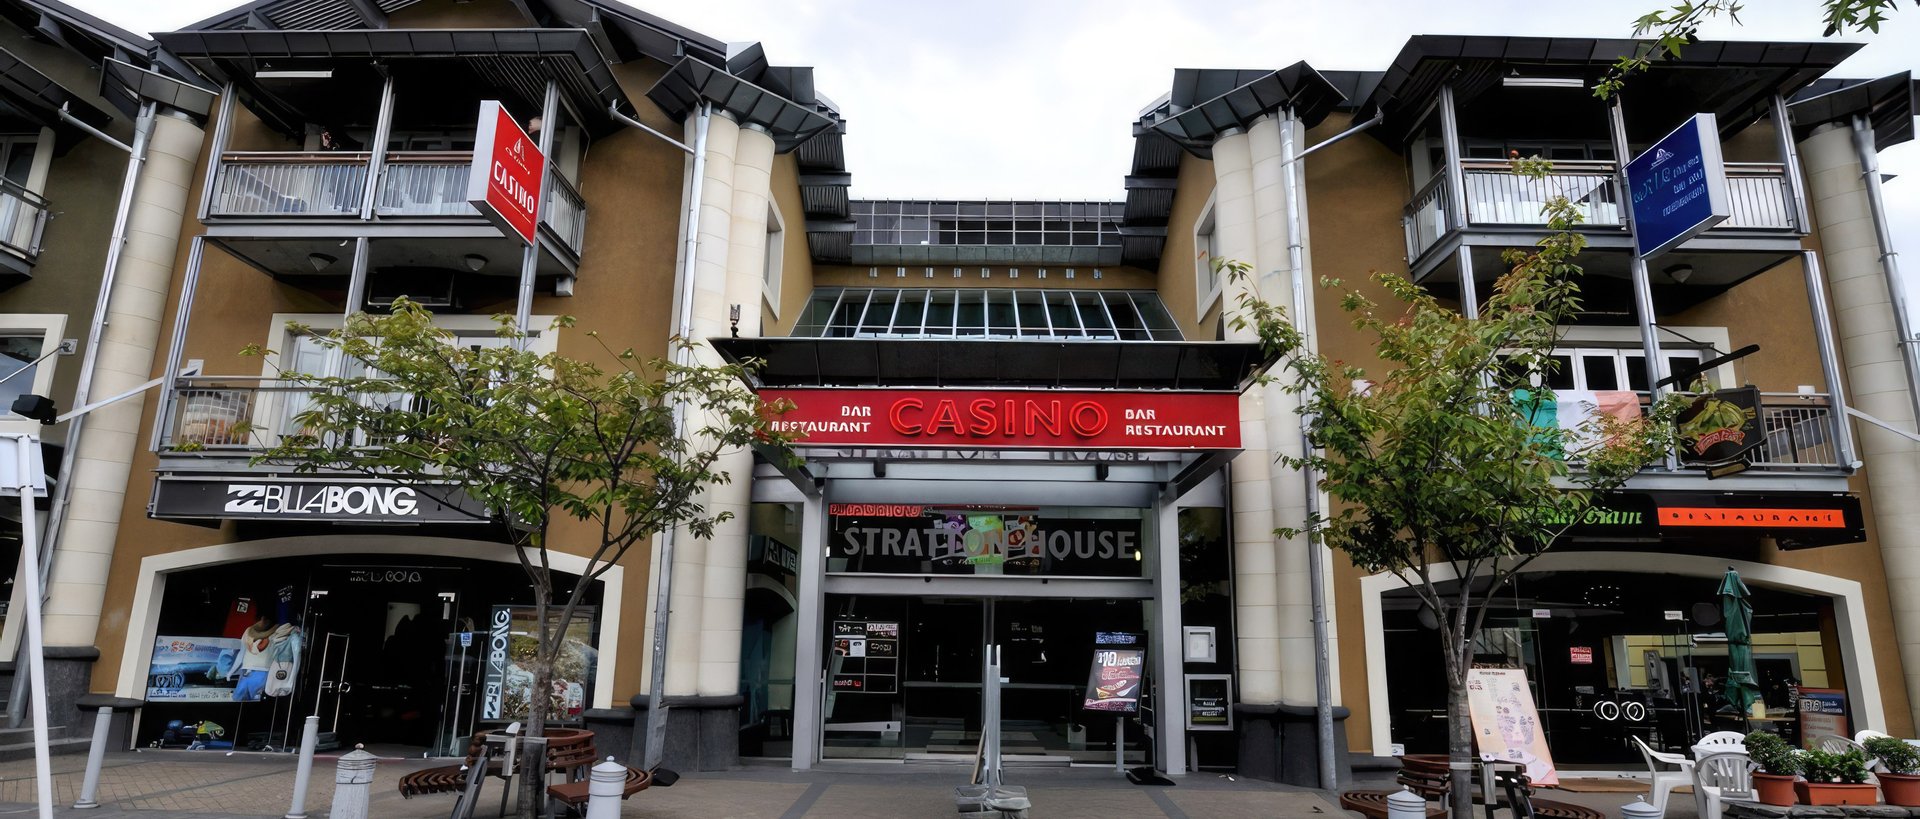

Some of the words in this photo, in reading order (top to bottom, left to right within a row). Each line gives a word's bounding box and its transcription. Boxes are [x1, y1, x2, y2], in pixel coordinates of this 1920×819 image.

[494, 160, 535, 214] CASINO
[841, 405, 871, 417] BAR
[889, 397, 1109, 437] CASINO
[1125, 409, 1156, 420] BAR
[771, 421, 872, 433] RESTAURANT
[1125, 425, 1227, 436] RESTAURANT
[843, 526, 1008, 559] STRATTON
[1026, 530, 1136, 560] HOUSE
